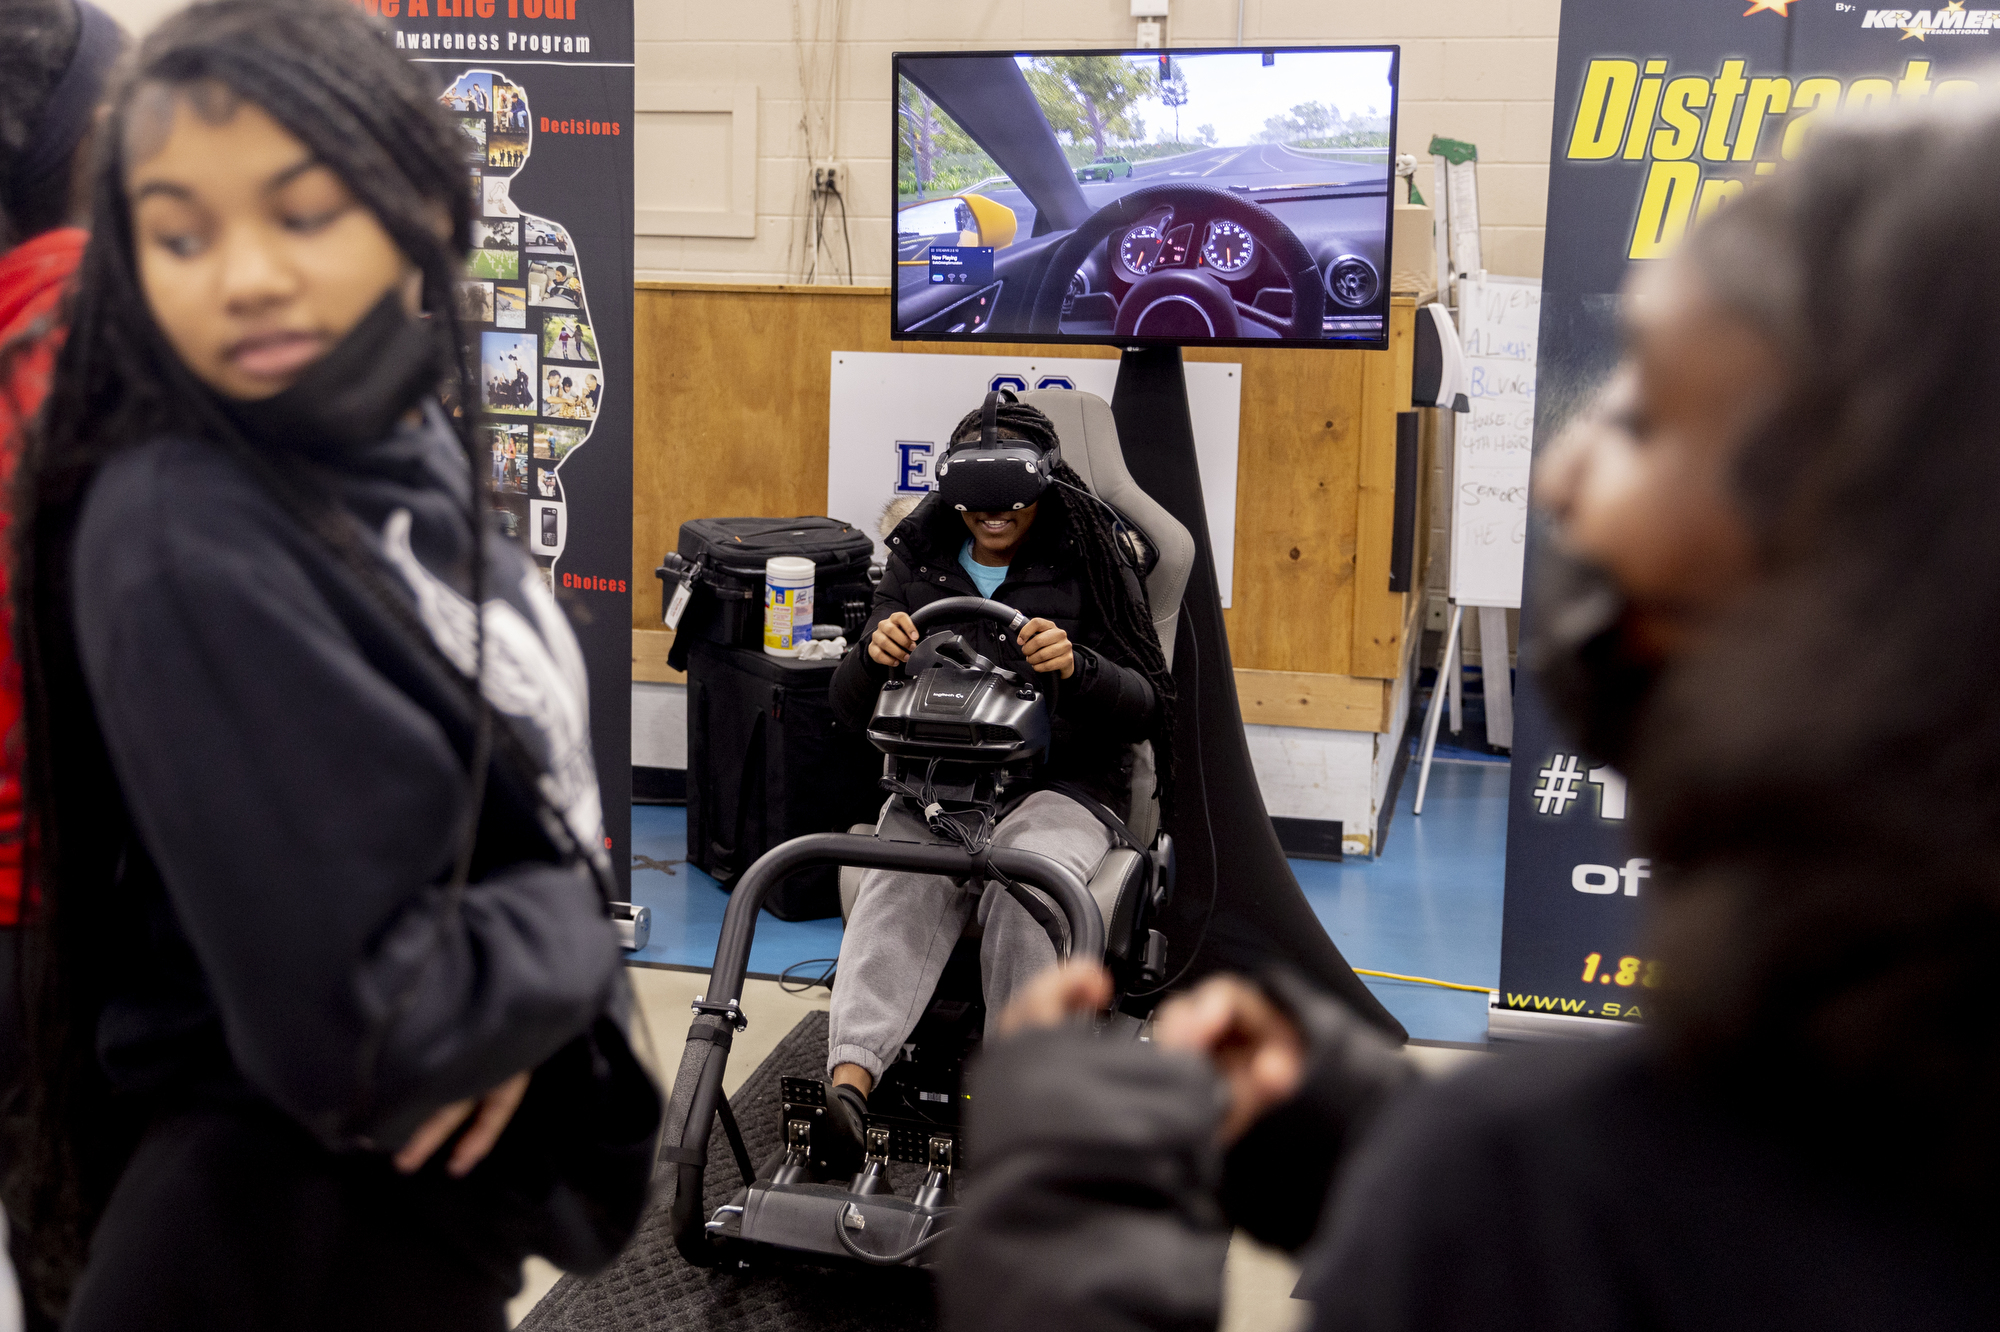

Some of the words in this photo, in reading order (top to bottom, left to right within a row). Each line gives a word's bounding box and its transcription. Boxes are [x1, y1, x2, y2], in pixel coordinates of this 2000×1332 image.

[1835, 2, 1856, 13] By:
[1861, 10, 2000, 29] KRAMER
[396, 31, 499, 50] Awareness
[508, 32, 590, 53] Program
[541, 117, 620, 136] Decisions
[563, 573, 626, 593] Choices
[1533, 754, 1627, 819] #1
[1571, 858, 1651, 897] of
